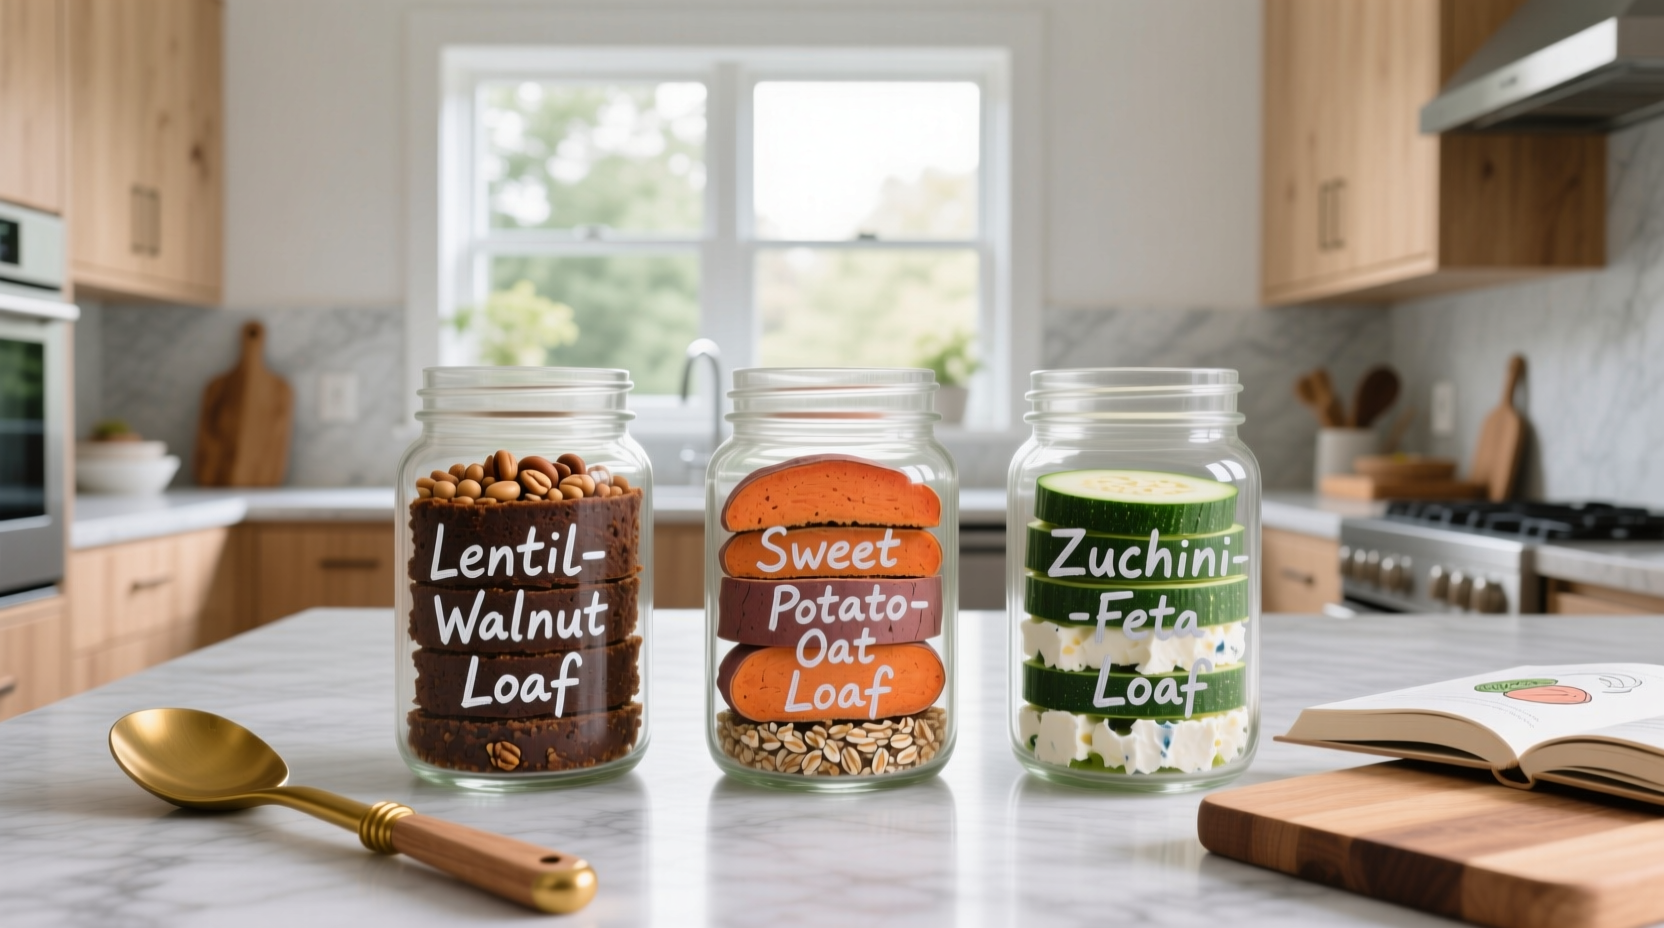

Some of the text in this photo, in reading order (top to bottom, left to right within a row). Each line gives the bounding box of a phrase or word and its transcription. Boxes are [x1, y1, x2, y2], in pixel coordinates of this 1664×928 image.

[430, 522, 606, 581] Lentil-
[756, 526, 901, 573] Sweet
[1047, 527, 1249, 579] Zuchini-
[434, 589, 609, 645] Walnut
[768, 584, 929, 631] Potato-
[1068, 590, 1206, 644] -Feta
[796, 627, 877, 668] Oat
[460, 651, 583, 718] Loaf
[784, 665, 894, 720] Loaf
[1092, 654, 1214, 719] Loaf
